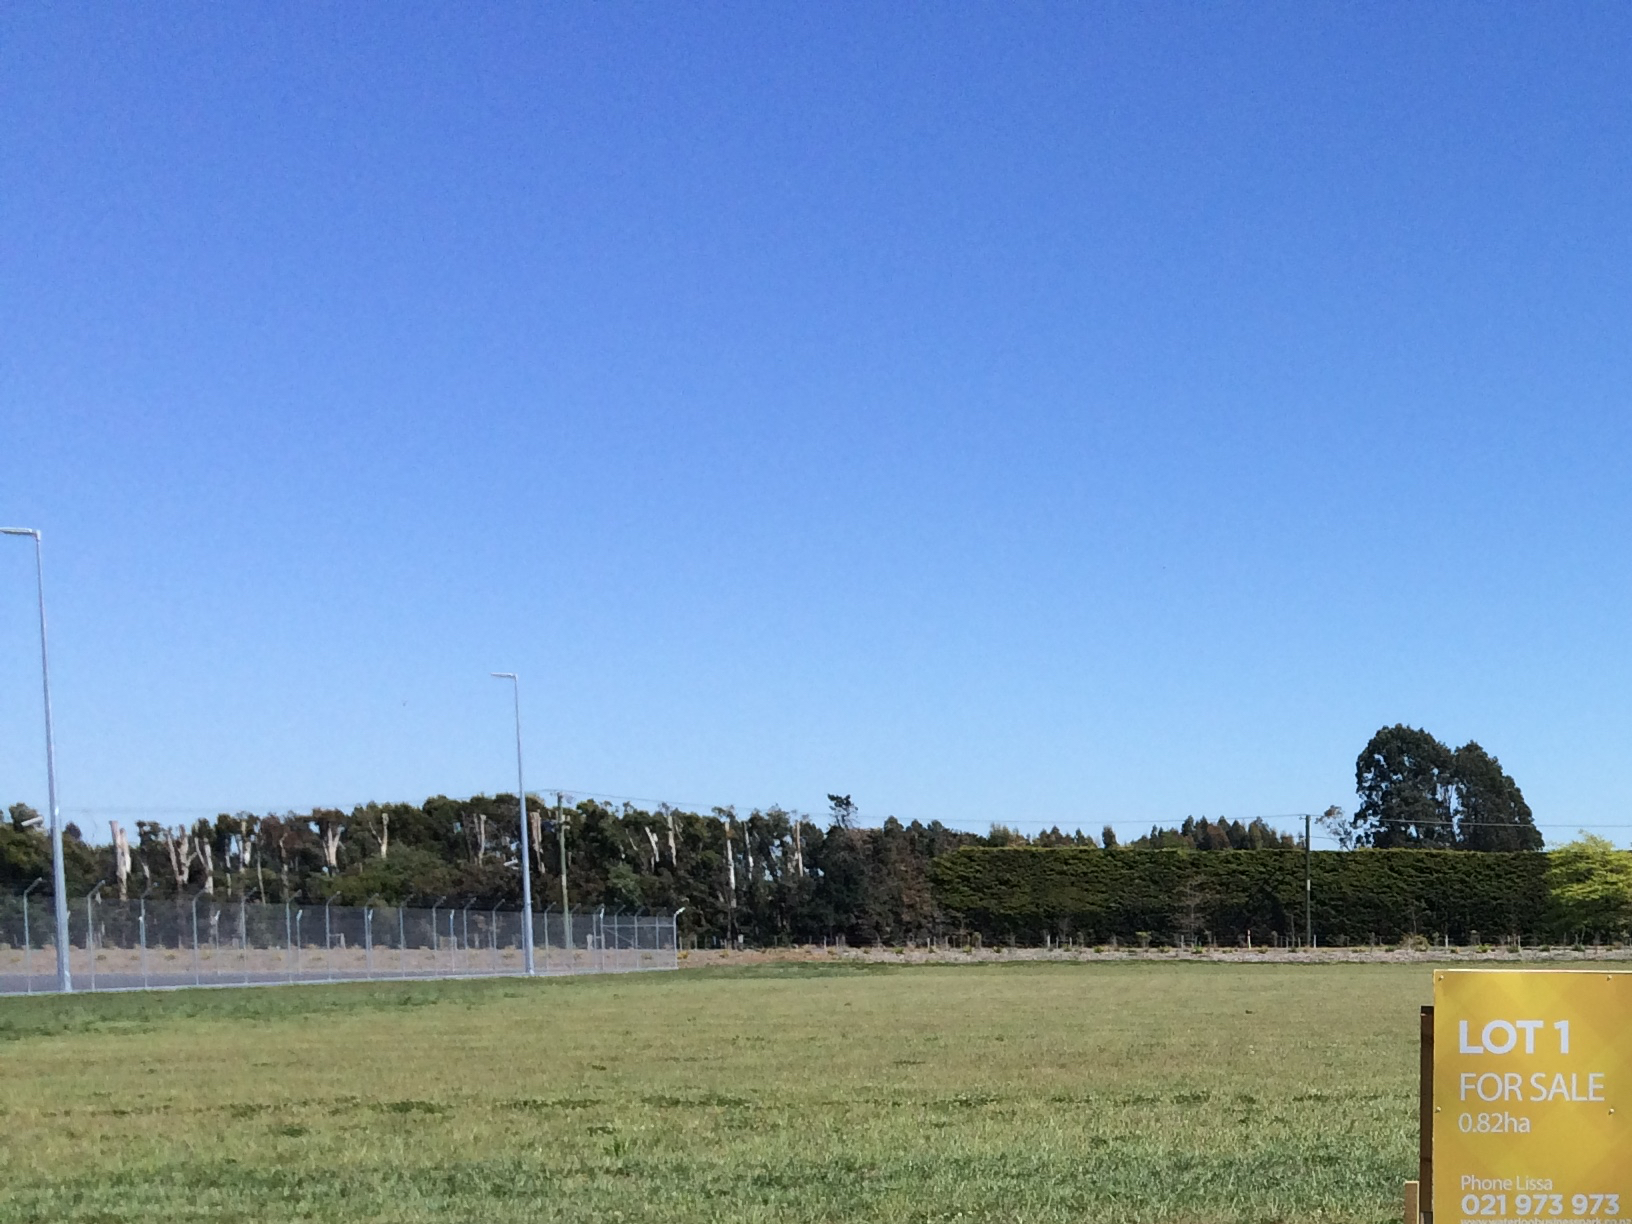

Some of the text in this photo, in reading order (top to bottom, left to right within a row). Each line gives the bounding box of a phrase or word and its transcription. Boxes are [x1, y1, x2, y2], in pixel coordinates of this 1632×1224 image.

[1459, 1020, 1570, 1054] LOT 1
[1459, 1073, 1605, 1102] FOR SALE
[1458, 1112, 1530, 1134] 0.82ha
[1461, 1175, 1553, 1191] Phone Lissa
[1461, 1194, 1619, 1215] 021 973 973
